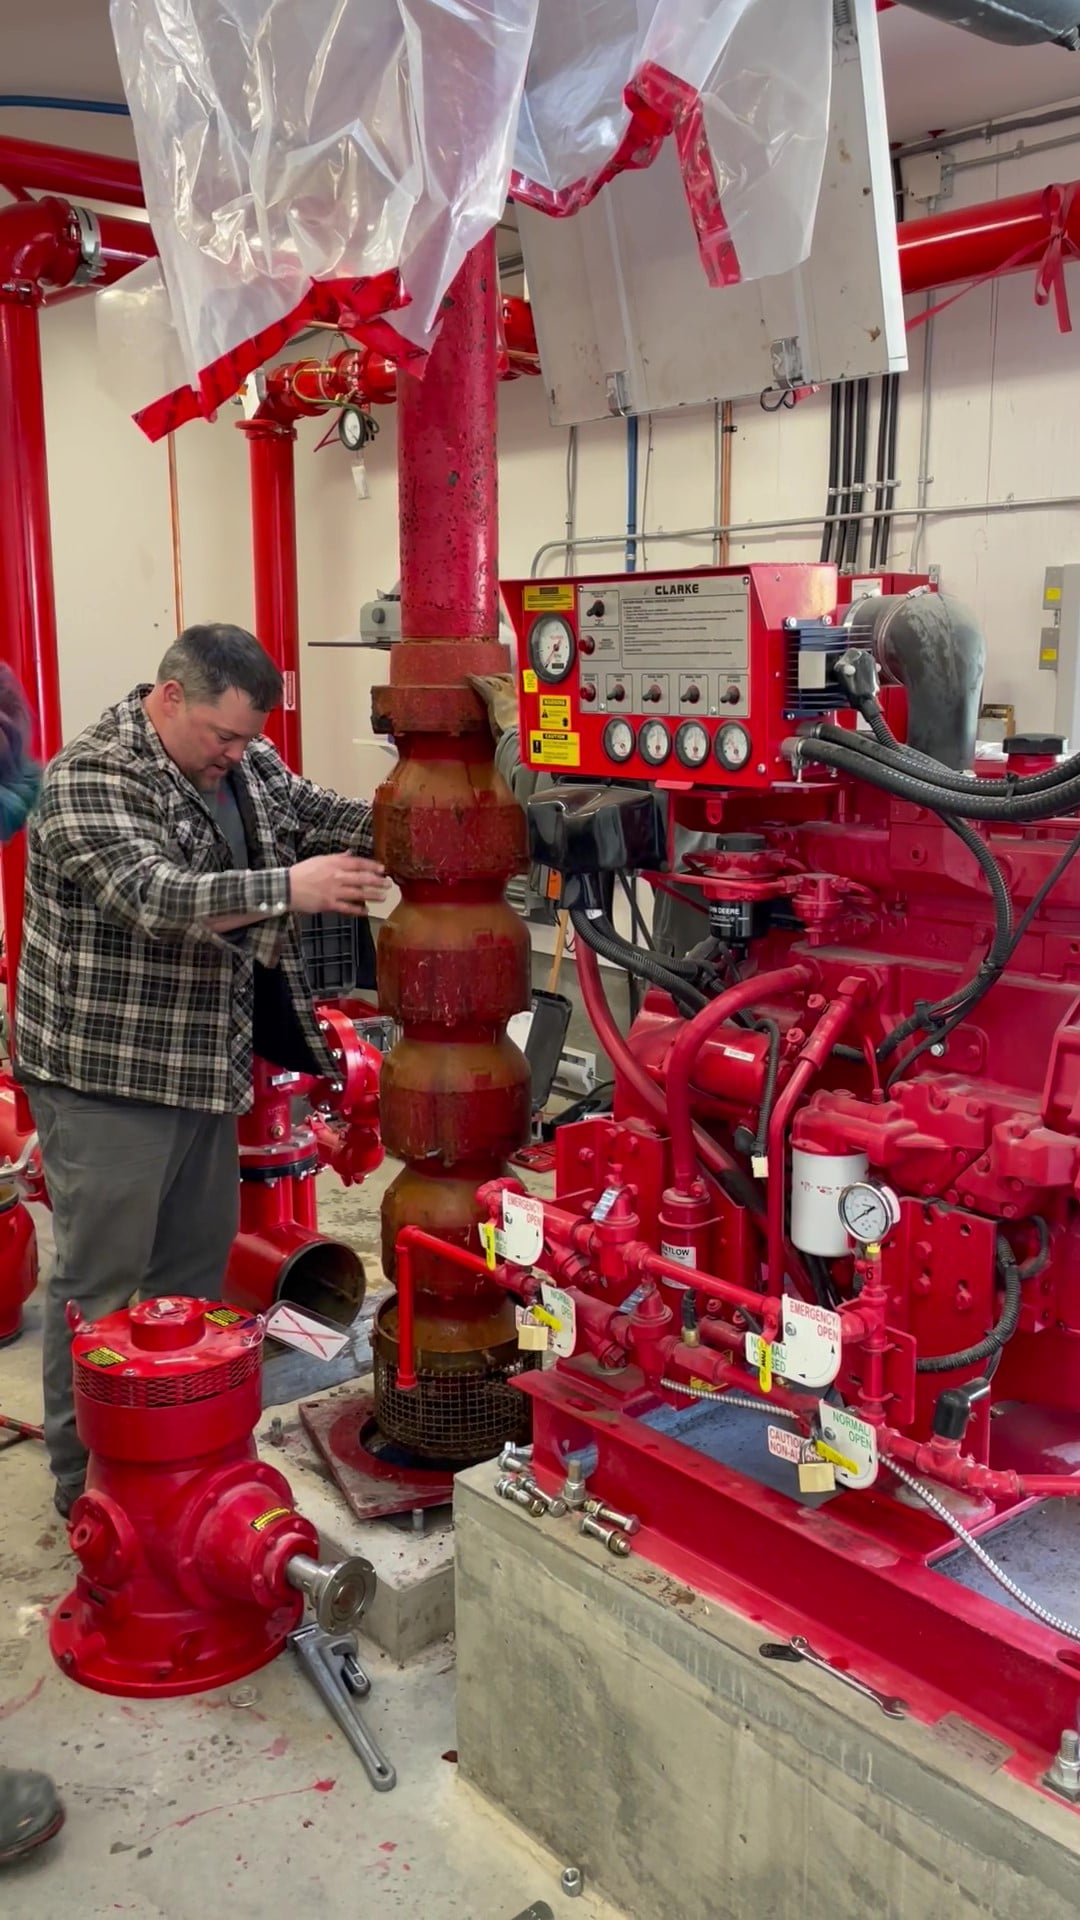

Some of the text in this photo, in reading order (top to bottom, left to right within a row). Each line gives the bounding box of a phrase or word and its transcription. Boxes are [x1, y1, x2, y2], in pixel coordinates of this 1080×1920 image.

[655, 584, 699, 595] CLARKE
[817, 1324, 839, 1342] OPEN
[753, 1351, 786, 1373] CSED
[849, 1430, 872, 1451] OPEN
